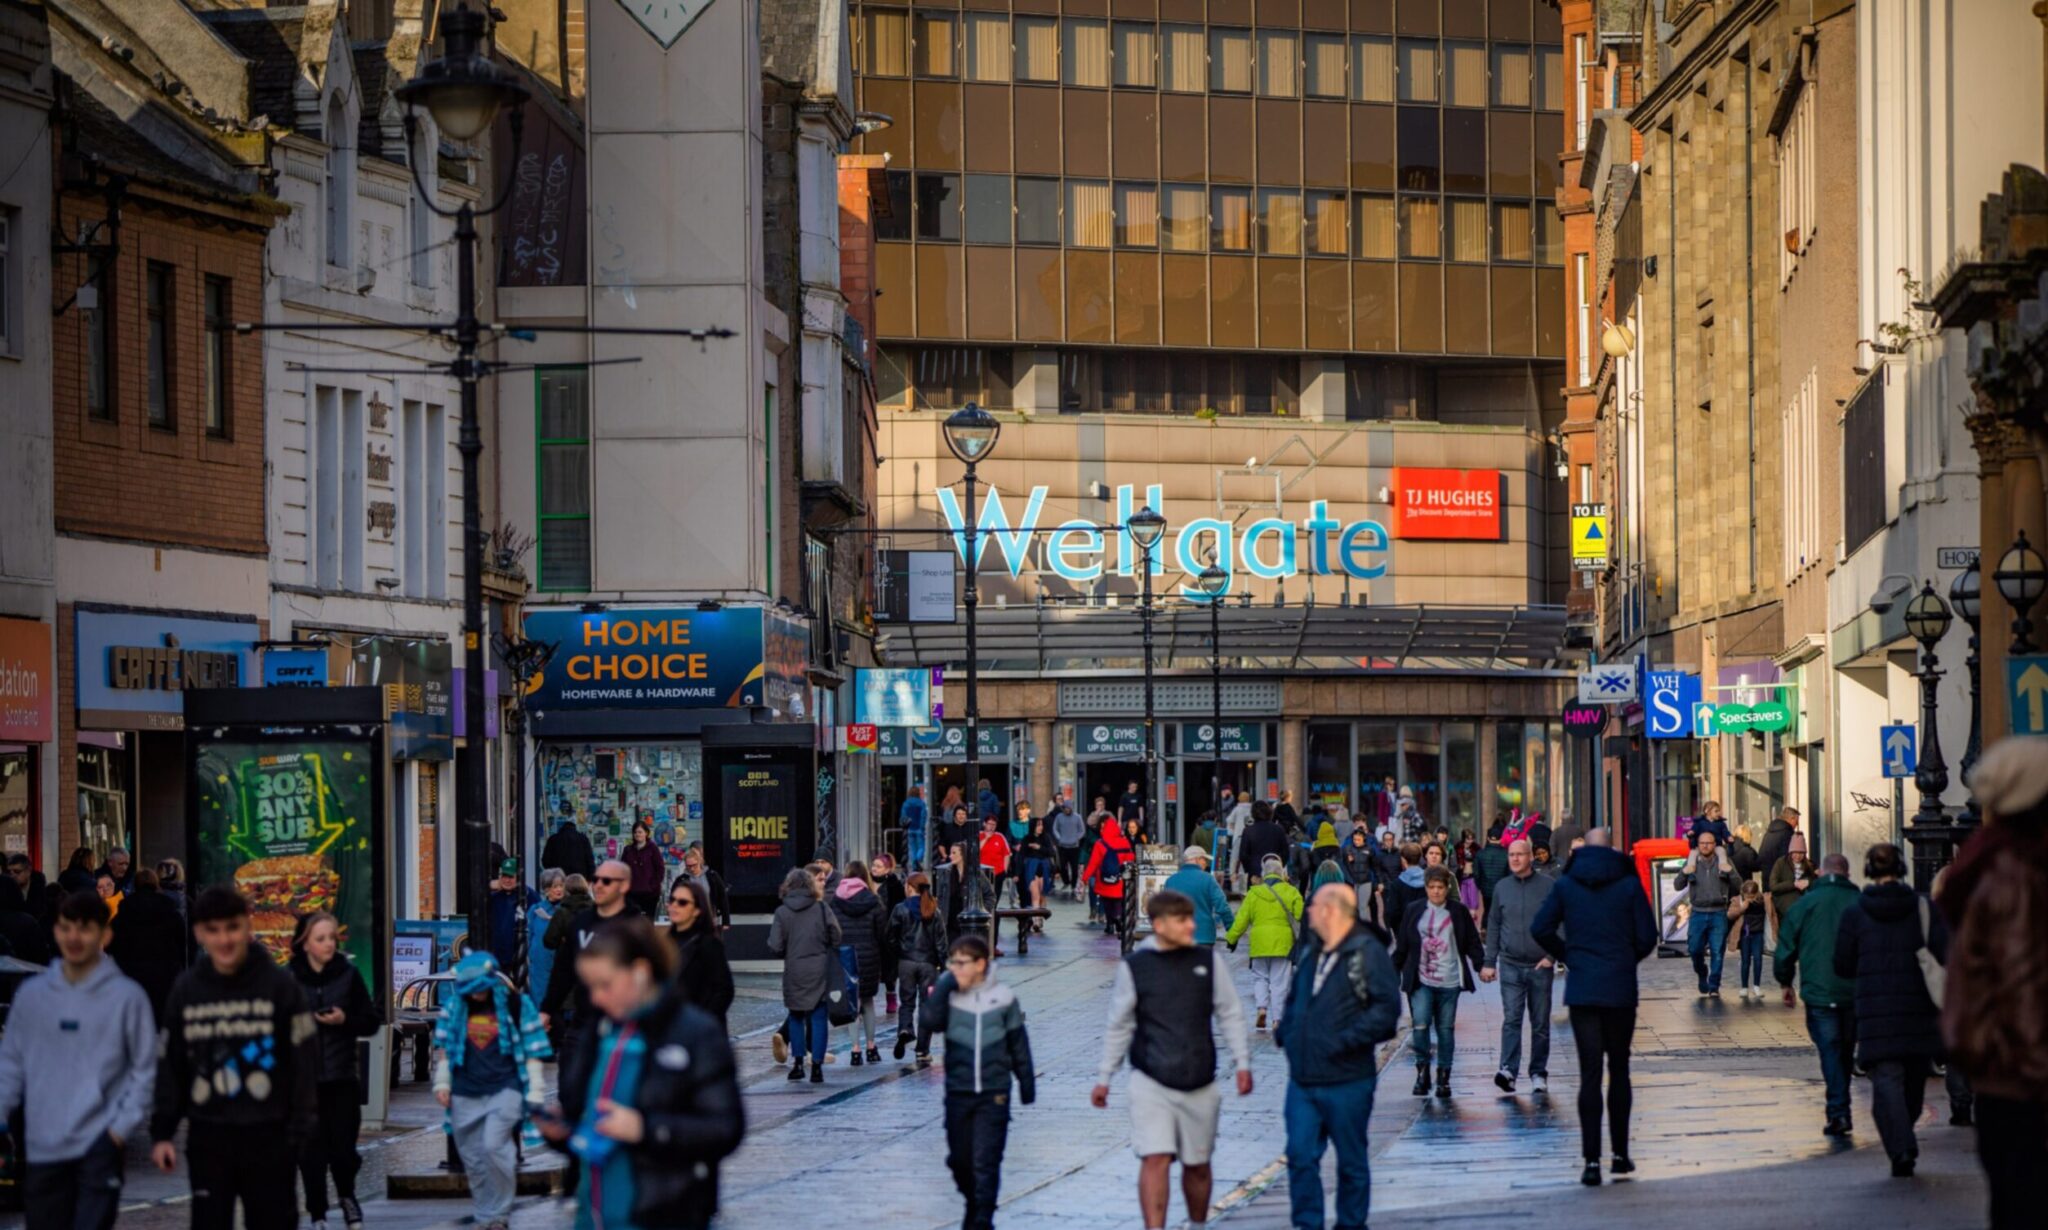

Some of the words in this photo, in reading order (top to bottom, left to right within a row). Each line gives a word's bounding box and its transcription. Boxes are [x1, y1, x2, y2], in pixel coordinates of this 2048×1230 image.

[1406, 489, 1422, 505] TJ
[1428, 489, 1493, 506] HUGHES
[1574, 505, 1591, 517] TO
[1593, 505, 1606, 517] LE
[936, 484, 1389, 602] Wellgate
[583, 619, 691, 646] HOME
[566, 652, 708, 681] CHOICE
[1652, 675, 1680, 689] WH
[561, 688, 633, 700] HOMEWARE
[636, 688, 644, 699] &
[647, 687, 716, 699] HARDWARE
[1565, 709, 1601, 725] HMV
[1652, 688, 1682, 734] S
[1719, 711, 1783, 725] Specsavers
[851, 726, 872, 736] JUST
[855, 733, 872, 742] EAT
[1113, 728, 1137, 740] GYMS
[1087, 744, 1099, 752] UP
[1101, 743, 1113, 752] ON
[1114, 743, 1139, 752] LEVEL
[1193, 742, 1204, 750] UP
[1243, 742, 1249, 750] 3
[258, 753, 302, 767] SUBWAY
[738, 779, 780, 787] SCOTLAND
[256, 794, 313, 820] ANY
[257, 816, 316, 844] SUB
[730, 816, 789, 840] HOME
